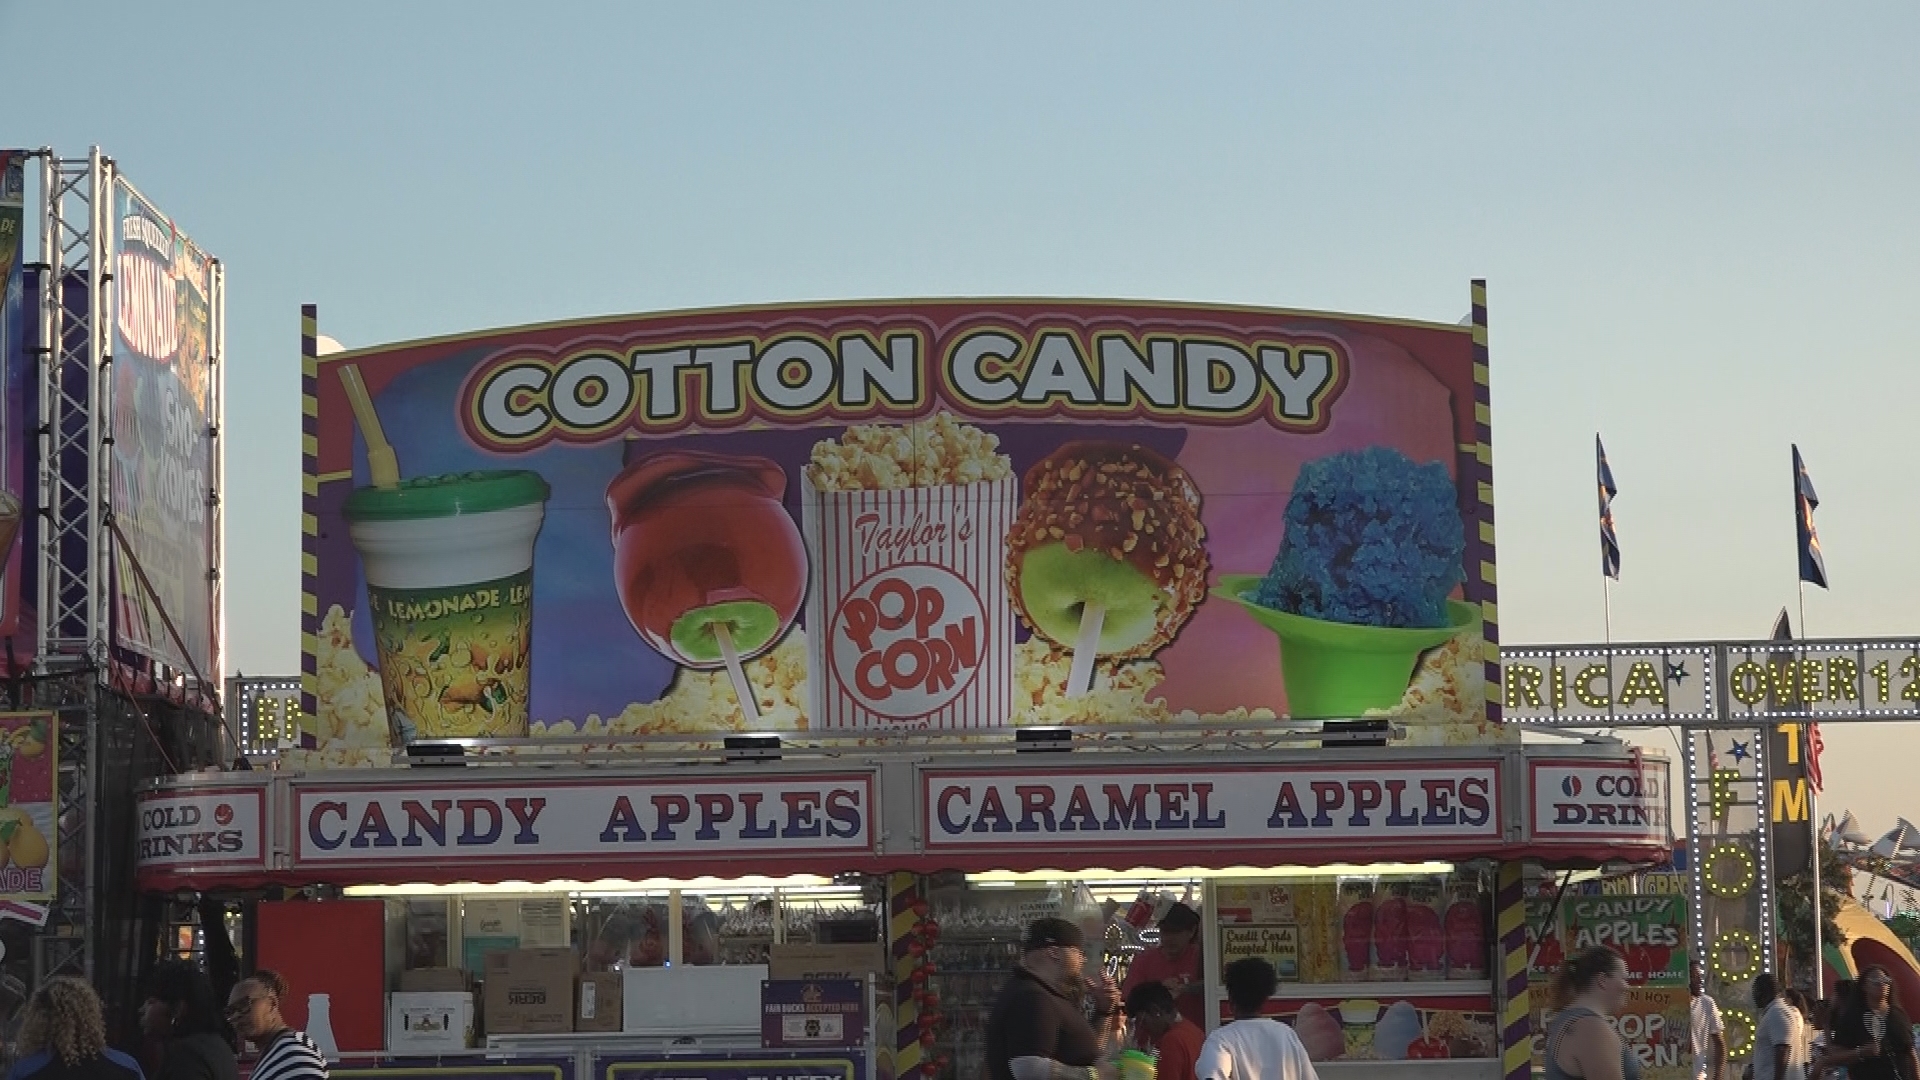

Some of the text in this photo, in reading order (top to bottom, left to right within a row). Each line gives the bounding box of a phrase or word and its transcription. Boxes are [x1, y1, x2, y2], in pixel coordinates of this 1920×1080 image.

[478, 328, 1333, 441] COTTON CANDY
[854, 503, 973, 561] Taylor's
[388, 589, 501, 621] LEMONADE
[842, 577, 945, 653] POP
[855, 615, 977, 701] CORN
[1729, 657, 1859, 707] OVER
[143, 805, 202, 831] COLD
[308, 789, 862, 850] CANDY APPLES
[937, 777, 1490, 834] CARAMEL APPLES
[1552, 803, 1665, 827] DRINK
[138, 829, 244, 859] RINKS
[1575, 897, 1673, 918] CANDY
[1224, 941, 1296, 956] Accepted Here
[1226, 929, 1292, 942] Credit Cards
[1575, 919, 1680, 949] APPLES
[1626, 970, 1684, 979] ME HOME
[1645, 991, 1671, 1005] HOT
